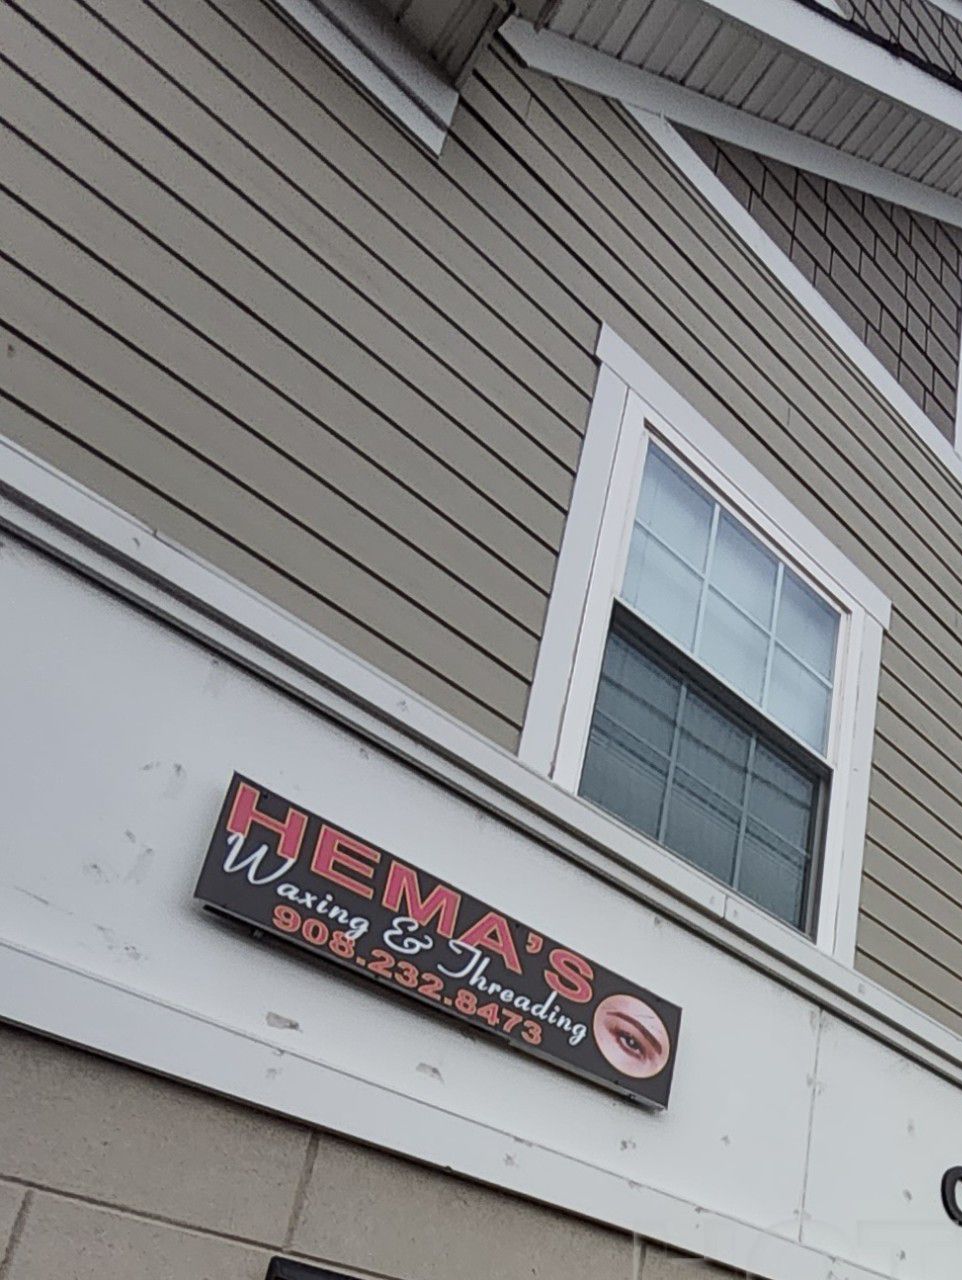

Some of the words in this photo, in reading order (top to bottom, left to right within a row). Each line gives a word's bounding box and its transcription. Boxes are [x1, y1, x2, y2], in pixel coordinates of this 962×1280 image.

[225, 832, 369, 939] Waxing
[383, 916, 433, 954] &
[437, 939, 587, 1046] Threading
[226, 781, 594, 1003] HEMA'S
[272, 904, 542, 1046] 908.232.8473
